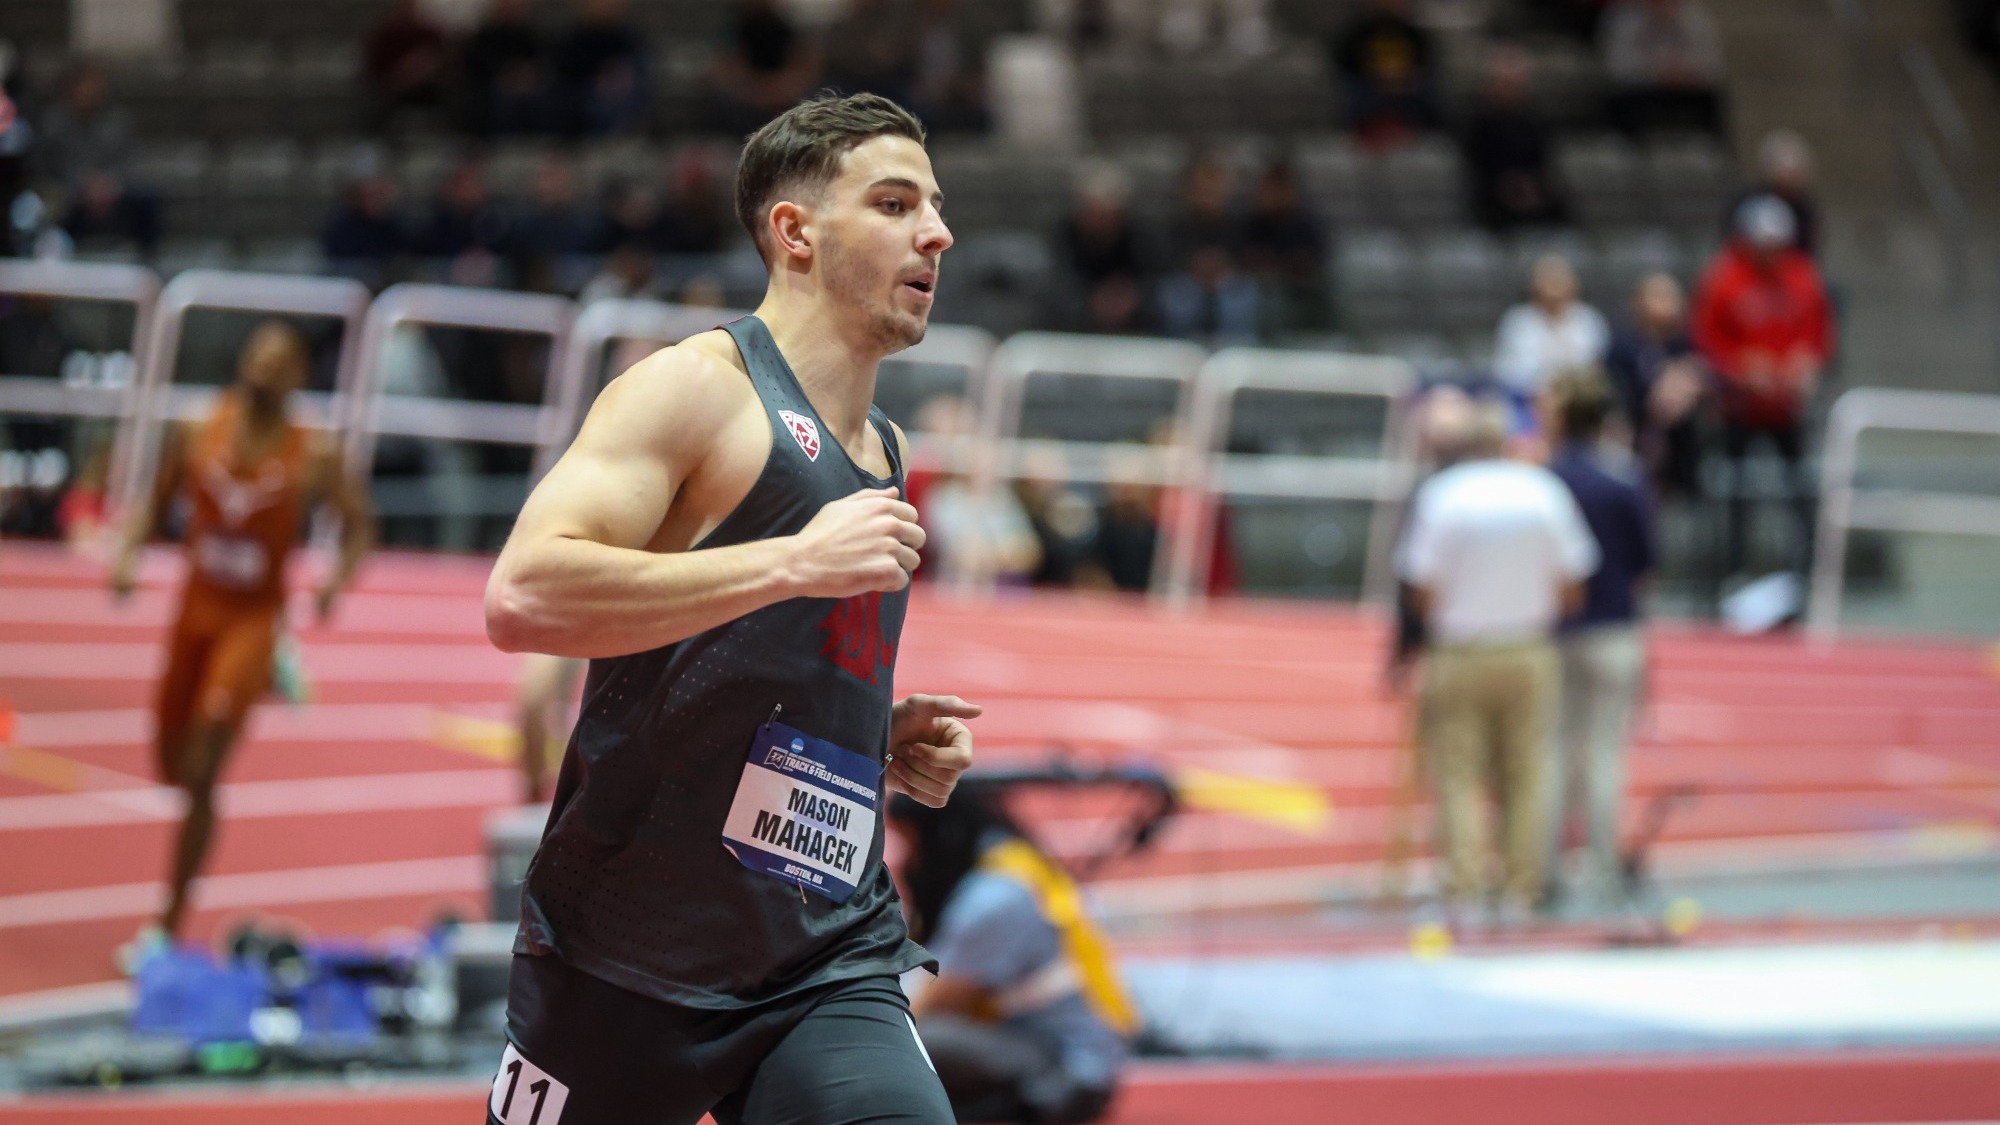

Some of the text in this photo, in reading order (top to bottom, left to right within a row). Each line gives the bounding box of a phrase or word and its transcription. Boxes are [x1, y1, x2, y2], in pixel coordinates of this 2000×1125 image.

[797, 430, 817, 451] 12
[785, 756, 811, 774] TRACK
[808, 765, 816, 775] &
[814, 767, 832, 782] FIELD
[787, 787, 851, 832] MASON
[751, 809, 858, 875] MAHACEK
[500, 1059, 551, 1125] 11
